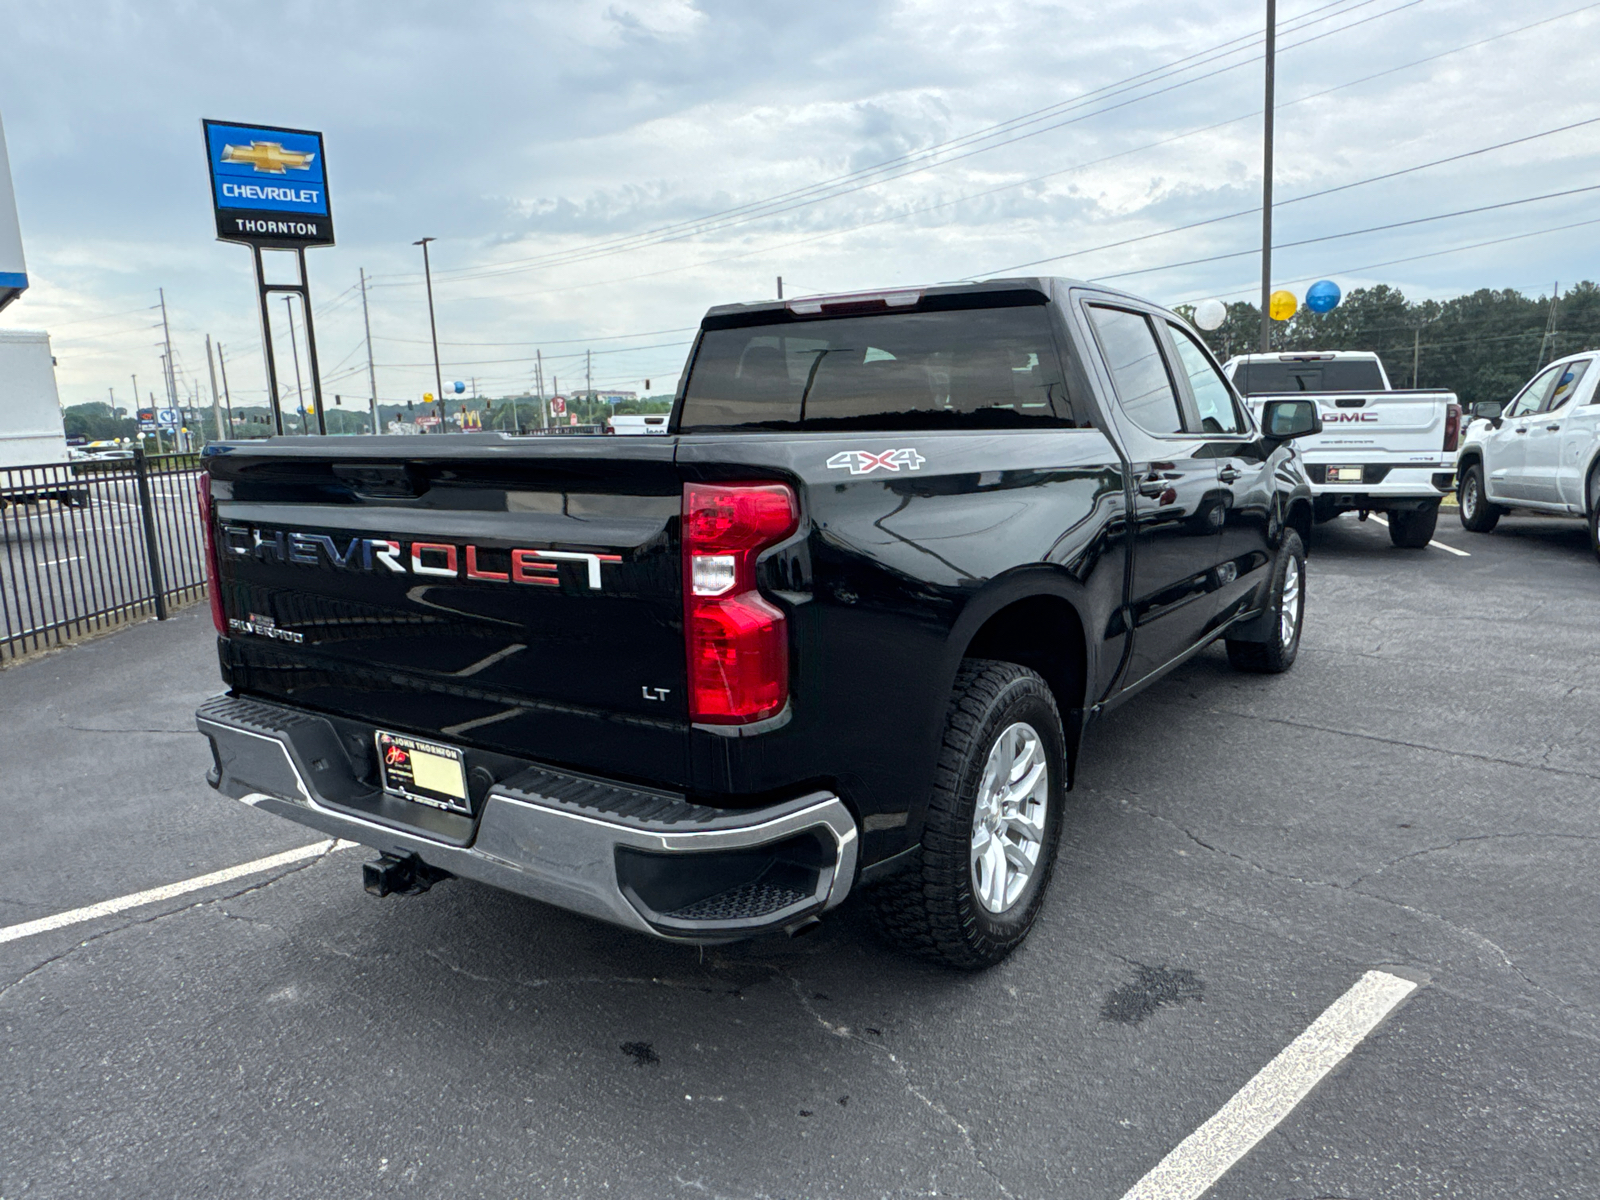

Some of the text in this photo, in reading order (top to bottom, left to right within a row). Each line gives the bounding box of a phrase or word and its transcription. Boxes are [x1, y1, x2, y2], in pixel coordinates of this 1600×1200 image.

[222, 183, 320, 204] CHEVROLET
[235, 218, 318, 236] THORNTON
[1321, 412, 1379, 423] GMC
[224, 525, 623, 590] CHEVROLET
[228, 617, 304, 644] SILVERADO
[641, 685, 671, 702] LT
[394, 737, 415, 749] JOHN
[415, 743, 458, 759] THORNTON
